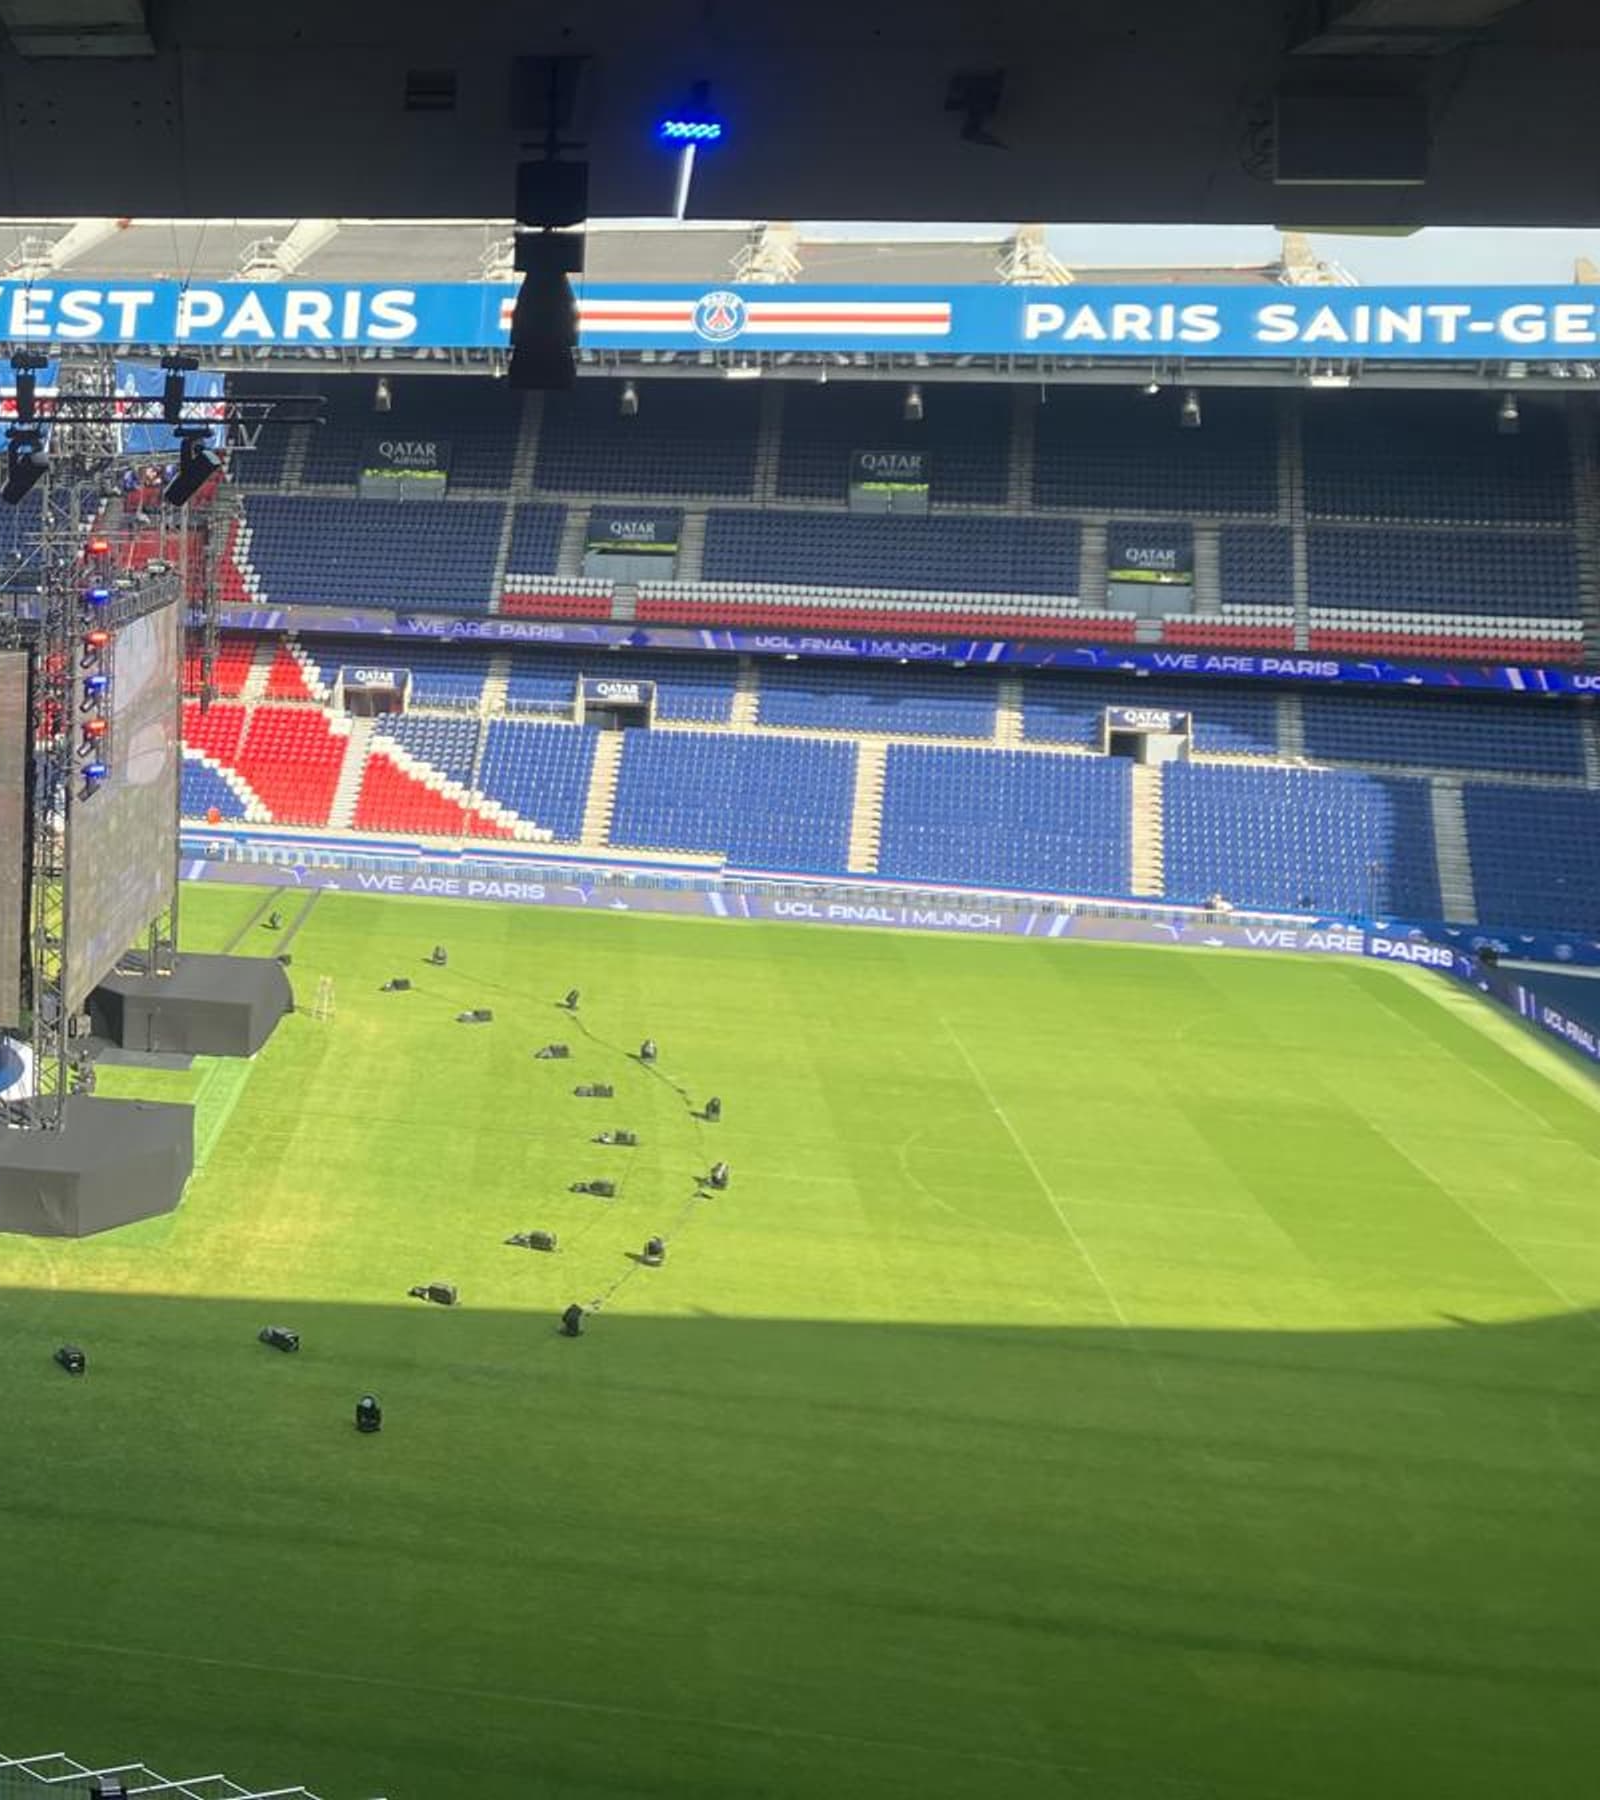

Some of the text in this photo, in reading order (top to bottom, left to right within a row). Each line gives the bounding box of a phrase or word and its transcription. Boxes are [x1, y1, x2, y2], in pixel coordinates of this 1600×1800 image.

[174, 289, 418, 341] PARIS
[1024, 303, 1597, 343] PARIS SAINT-GE
[379, 442, 437, 460] QATAR
[861, 454, 922, 471] QATAR
[610, 521, 656, 536] QATAR
[1126, 548, 1176, 563] QATAR
[408, 619, 564, 639] WE ARE PARIS
[755, 636, 795, 649] UCL
[799, 638, 856, 651] FINAL
[870, 640, 947, 656] MUNICH
[1152, 653, 1340, 677] WE ARE PARIS
[355, 669, 394, 682] QATAR
[597, 682, 639, 696] QATAR
[1124, 711, 1169, 724] QATAR
[357, 872, 545, 900] WE ARE PARIS
[774, 900, 822, 917] UCL
[828, 904, 895, 922] FINAL
[911, 909, 1002, 928] MUNICH
[1245, 928, 1453, 968] WE ARE PARIS
